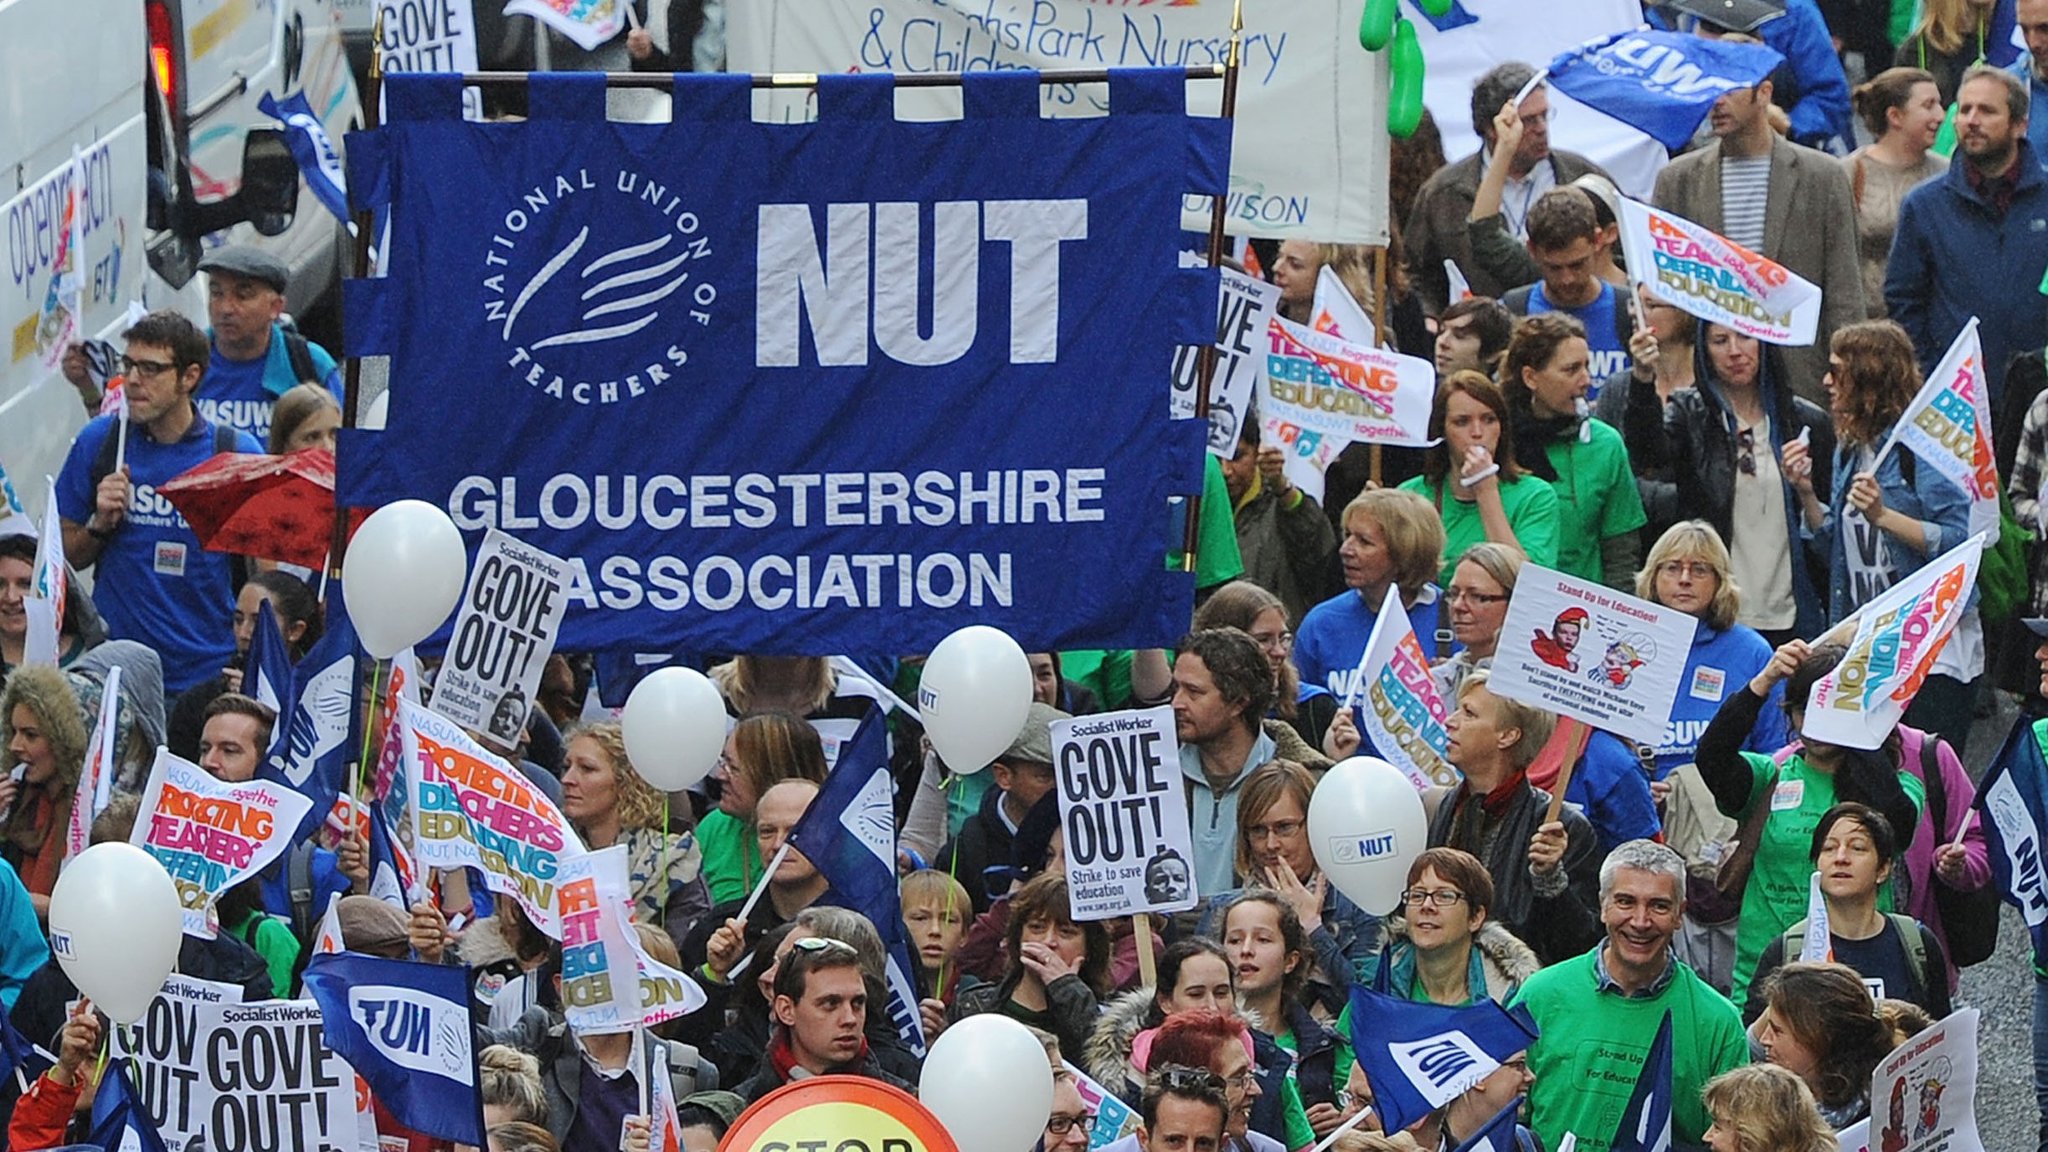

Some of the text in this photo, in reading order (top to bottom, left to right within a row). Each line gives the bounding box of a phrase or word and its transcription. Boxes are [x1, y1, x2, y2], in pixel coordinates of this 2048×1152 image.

[382, 0, 461, 50] GOVE
[861, 8, 892, 70] &
[1026, 0, 1105, 63] Park
[484, 168, 717, 405] NATIONAL UNION OF TEACHERS
[756, 199, 1088, 367] NUT
[1216, 289, 1262, 355] VE
[448, 468, 1106, 531] GLOUCESTERSHIRE
[473, 555, 560, 641] GOVE
[564, 552, 1013, 611] ASSOCIATION
[455, 614, 537, 692] OUT!
[440, 687, 482, 713] education
[1071, 717, 1153, 738] Socialist Worker
[1060, 731, 1169, 803] GOVE
[1068, 797, 1167, 866] OUT!
[1359, 835, 1394, 858] NUT
[1072, 866, 1142, 886] Strike to save
[1075, 883, 1125, 900] education
[180, 983, 223, 1002] Worker
[223, 1006, 322, 1023] Socialist Worke
[117, 995, 198, 1066] GOV
[206, 1024, 340, 1093] GOVE
[1598, 1048, 1644, 1066] Stand Up
[1586, 1068, 1602, 1079] For
[211, 1092, 332, 1152] OUT!
